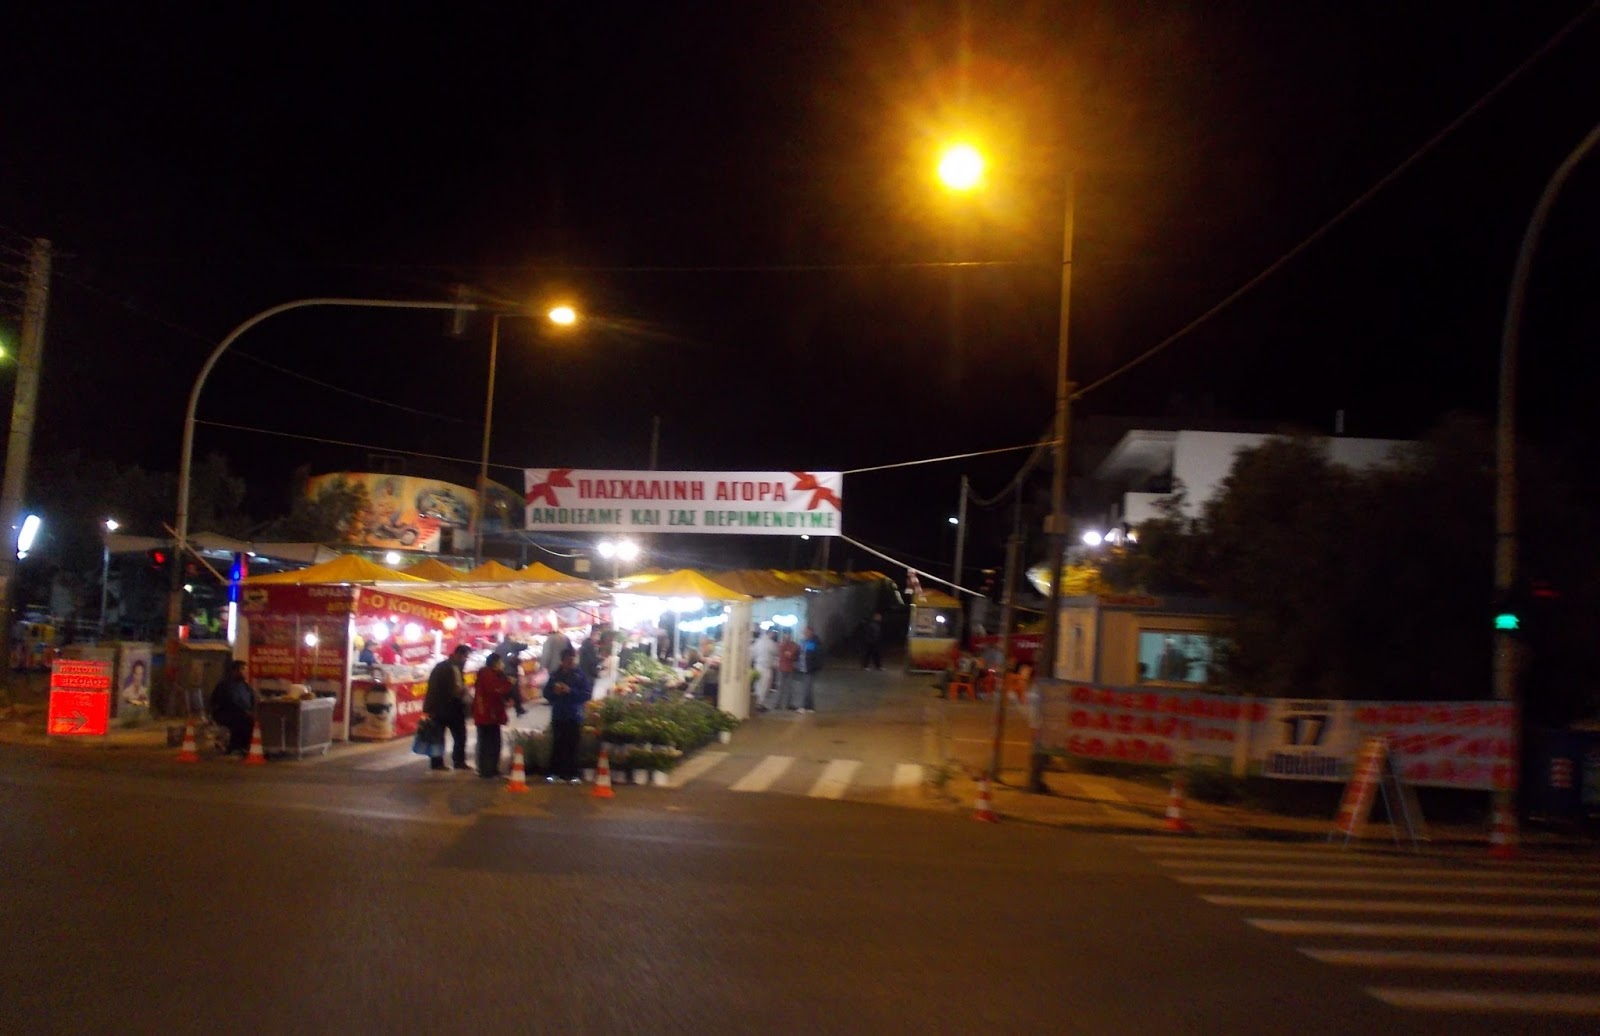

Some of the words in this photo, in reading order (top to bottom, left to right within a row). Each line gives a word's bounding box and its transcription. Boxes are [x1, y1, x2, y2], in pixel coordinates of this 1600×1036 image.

[577, 479, 705, 501] ΠΑΣΧΑΛΙΝΗ
[716, 480, 787, 503] ΑΓΟΡΑ
[531, 507, 623, 525] ΑΝΟΙΞΑΜΕ
[630, 508, 661, 525] ΚΑΙ
[668, 508, 697, 526] ΣΑΣ
[704, 510, 836, 529] ΠΕΡΙΜΕΝΟΥΜΕ
